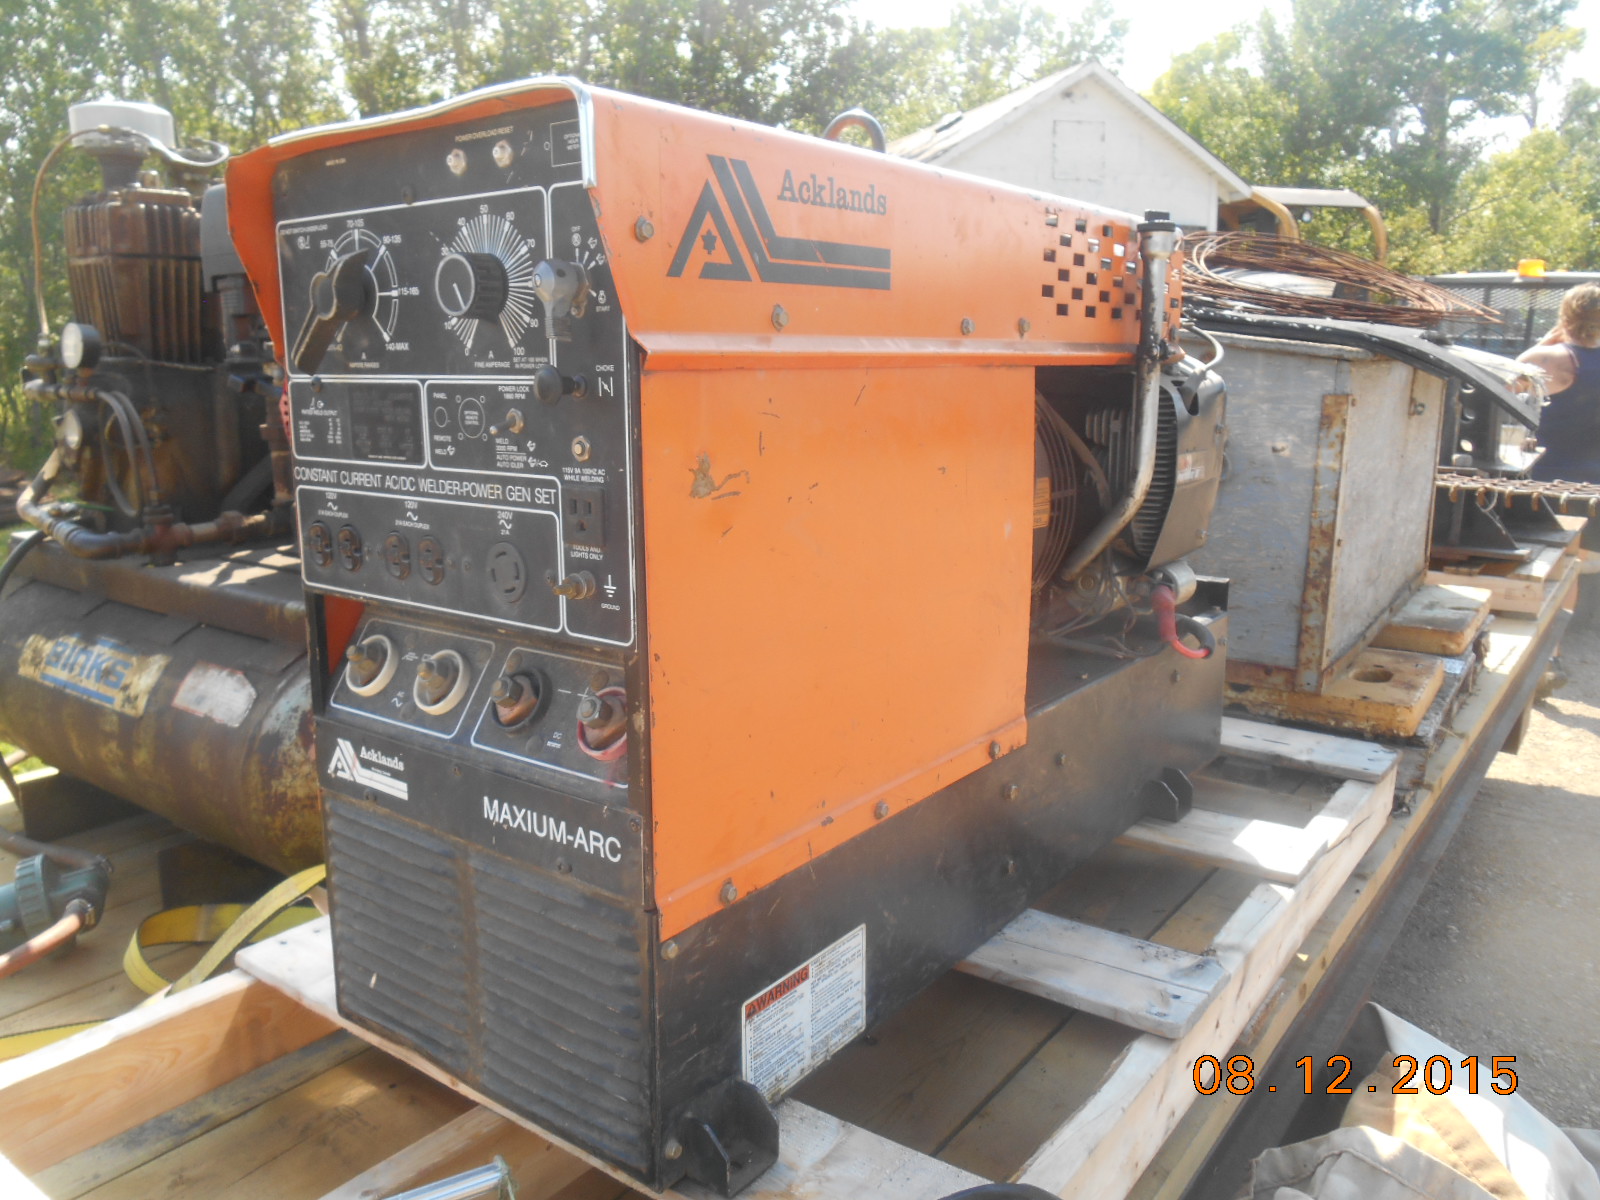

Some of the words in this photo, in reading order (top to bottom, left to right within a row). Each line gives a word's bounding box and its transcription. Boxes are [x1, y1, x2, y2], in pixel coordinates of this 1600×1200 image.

[777, 169, 887, 216] Acklands
[480, 205, 488, 213] 50
[506, 212, 515, 221] 60
[458, 218, 466, 226] 40
[527, 239, 535, 248] 70
[444, 321, 451, 330] 10
[530, 318, 538, 328] 90
[385, 343, 409, 351] 140-MAX
[464, 348, 469, 356] 0
[488, 351, 494, 359] A
[564, 474, 580, 482] WHILE
[581, 475, 604, 483] WELDING
[294, 467, 338, 483] CONSTANT
[340, 471, 382, 488] CURRENT
[385, 476, 416, 492] AC/DC
[420, 480, 502, 499] WELDER-POWER
[506, 486, 531, 502] GEN
[535, 488, 557, 505] SET
[497, 511, 513, 519] 240V
[570, 552, 588, 560] LIGHTS
[590, 553, 603, 561] ONLY
[601, 603, 620, 611] GROUND
[360, 746, 405, 771] Acklands
[483, 796, 622, 863] MAXIUM-ARC
[757, 967, 808, 1008] WARNING
